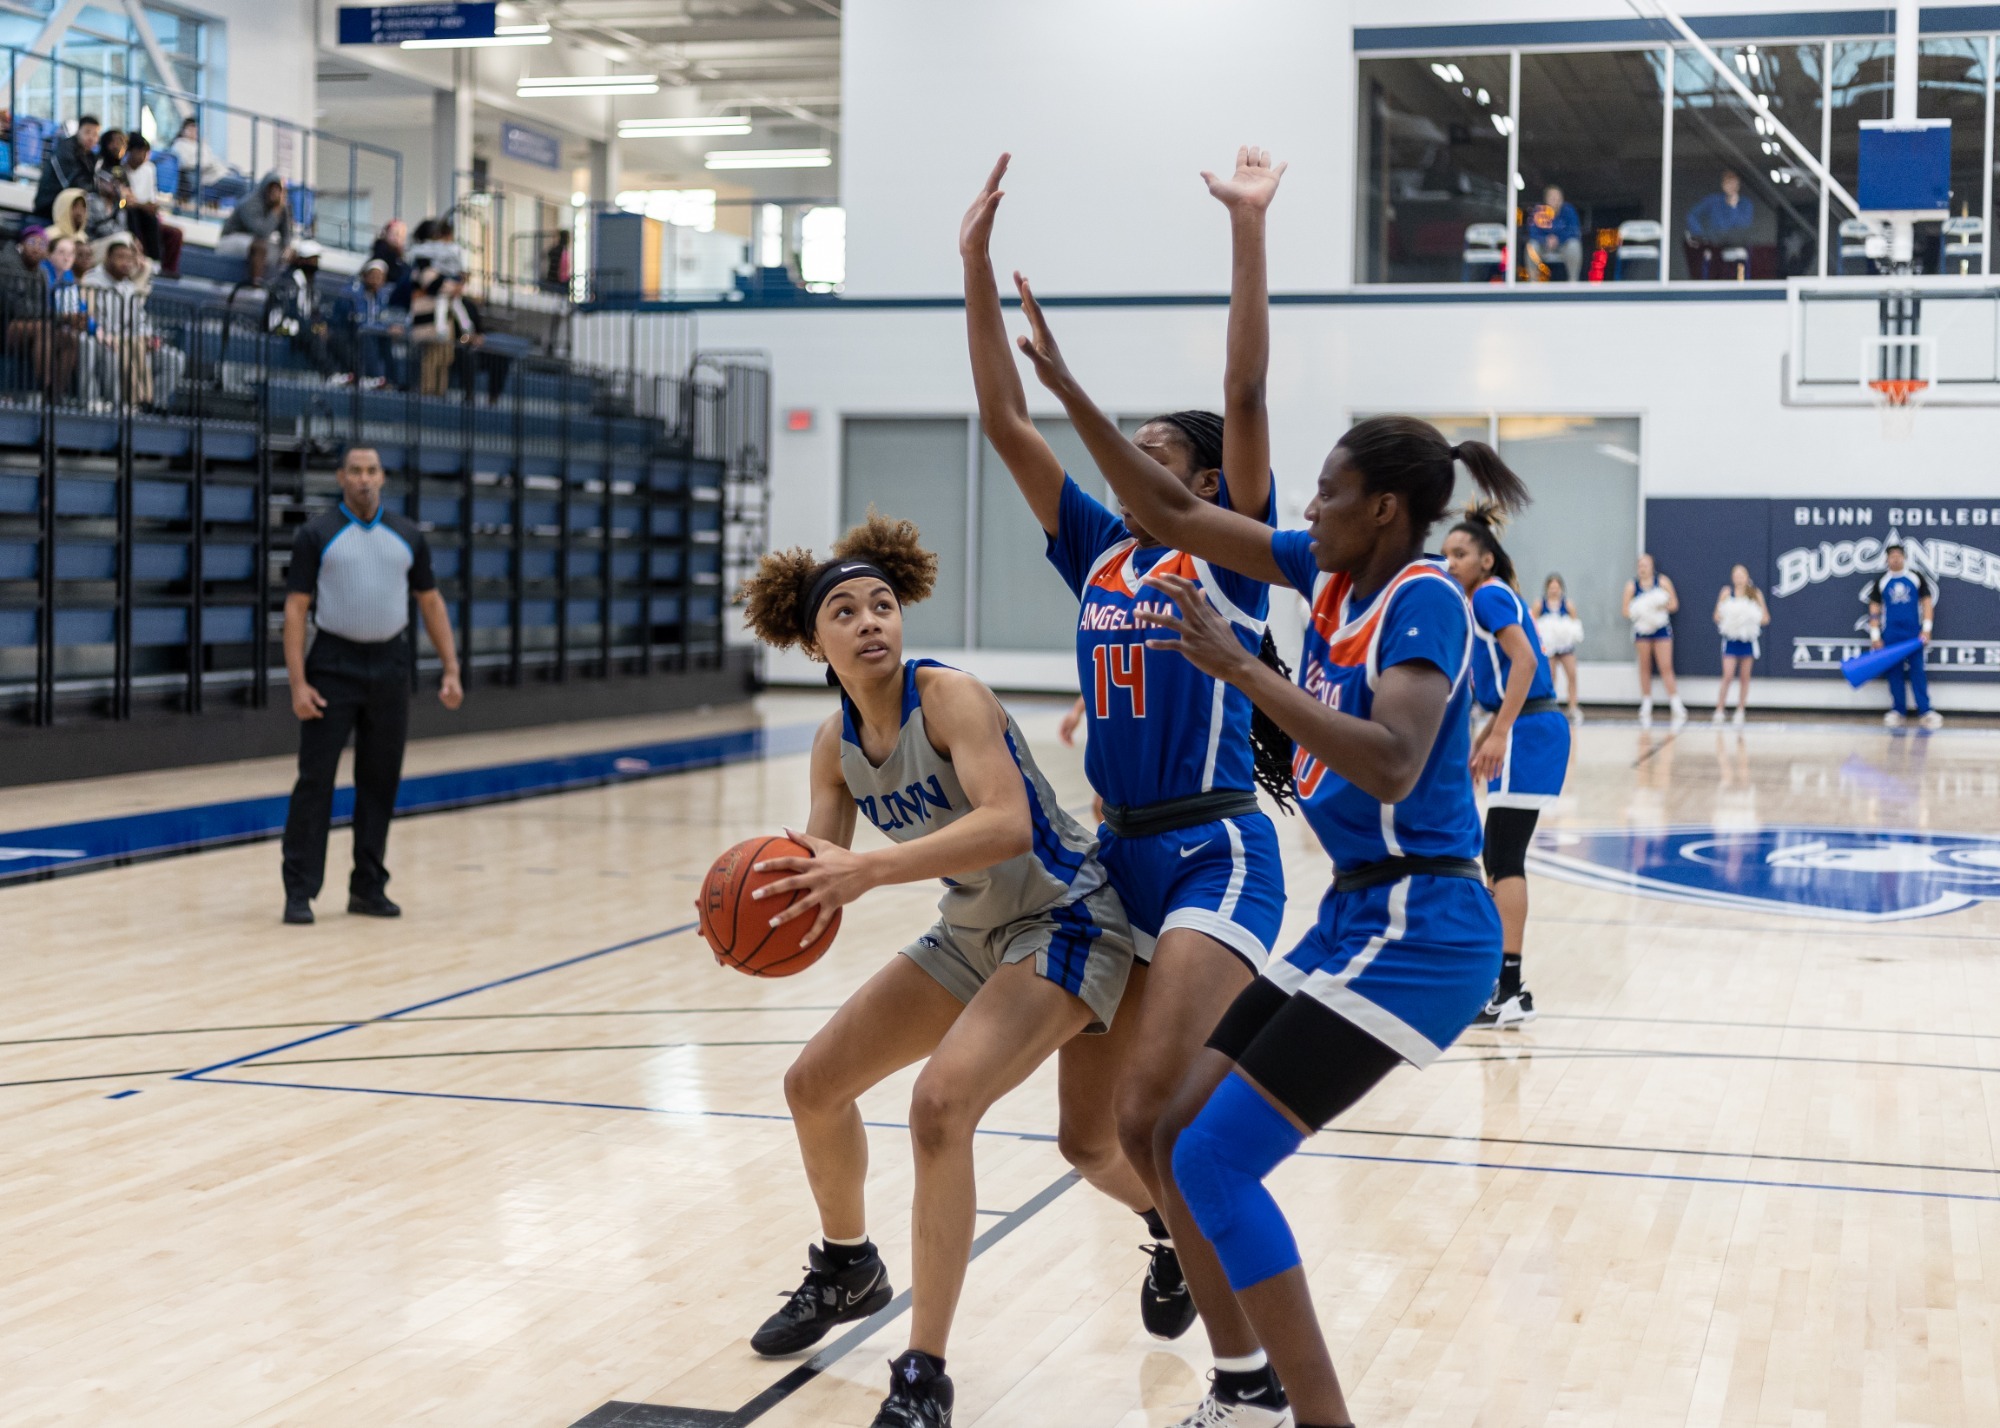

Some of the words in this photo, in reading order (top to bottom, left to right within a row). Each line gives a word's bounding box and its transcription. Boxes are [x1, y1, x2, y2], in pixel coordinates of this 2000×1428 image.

[1794, 506, 1873, 526] BLINN
[1888, 507, 2000, 526] COLLEGE
[1092, 643, 1146, 719] 14
